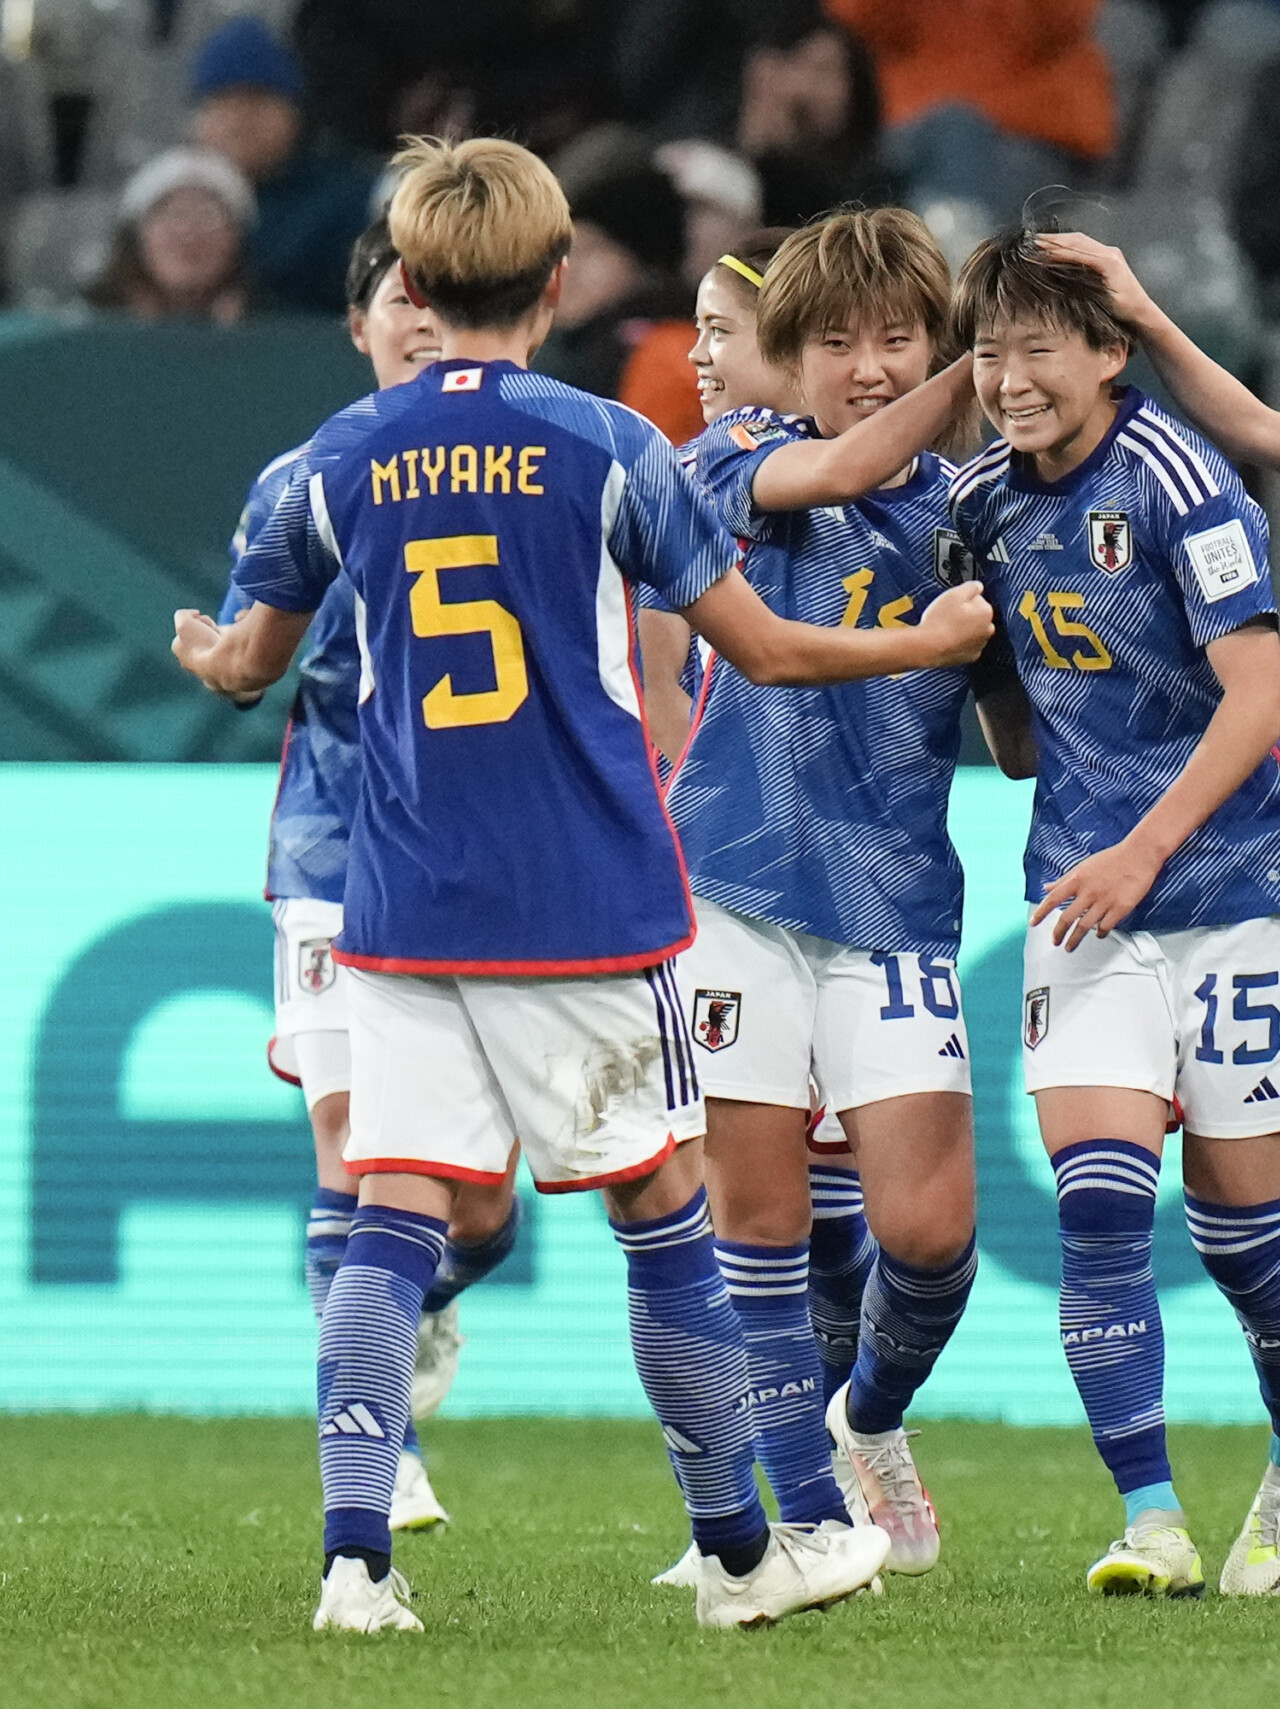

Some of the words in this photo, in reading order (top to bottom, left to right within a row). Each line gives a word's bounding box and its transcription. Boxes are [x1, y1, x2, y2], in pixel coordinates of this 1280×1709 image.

[370, 444, 547, 506] MIYAKE
[1200, 535, 1235, 553] FOOTBALL
[1203, 542, 1238, 565] UNITES
[403, 534, 530, 731] 5
[1018, 589, 1114, 671] 15
[705, 990, 732, 999] JAPAN
[869, 951, 960, 1021] 18
[732, 1375, 816, 1413] JAPAN
